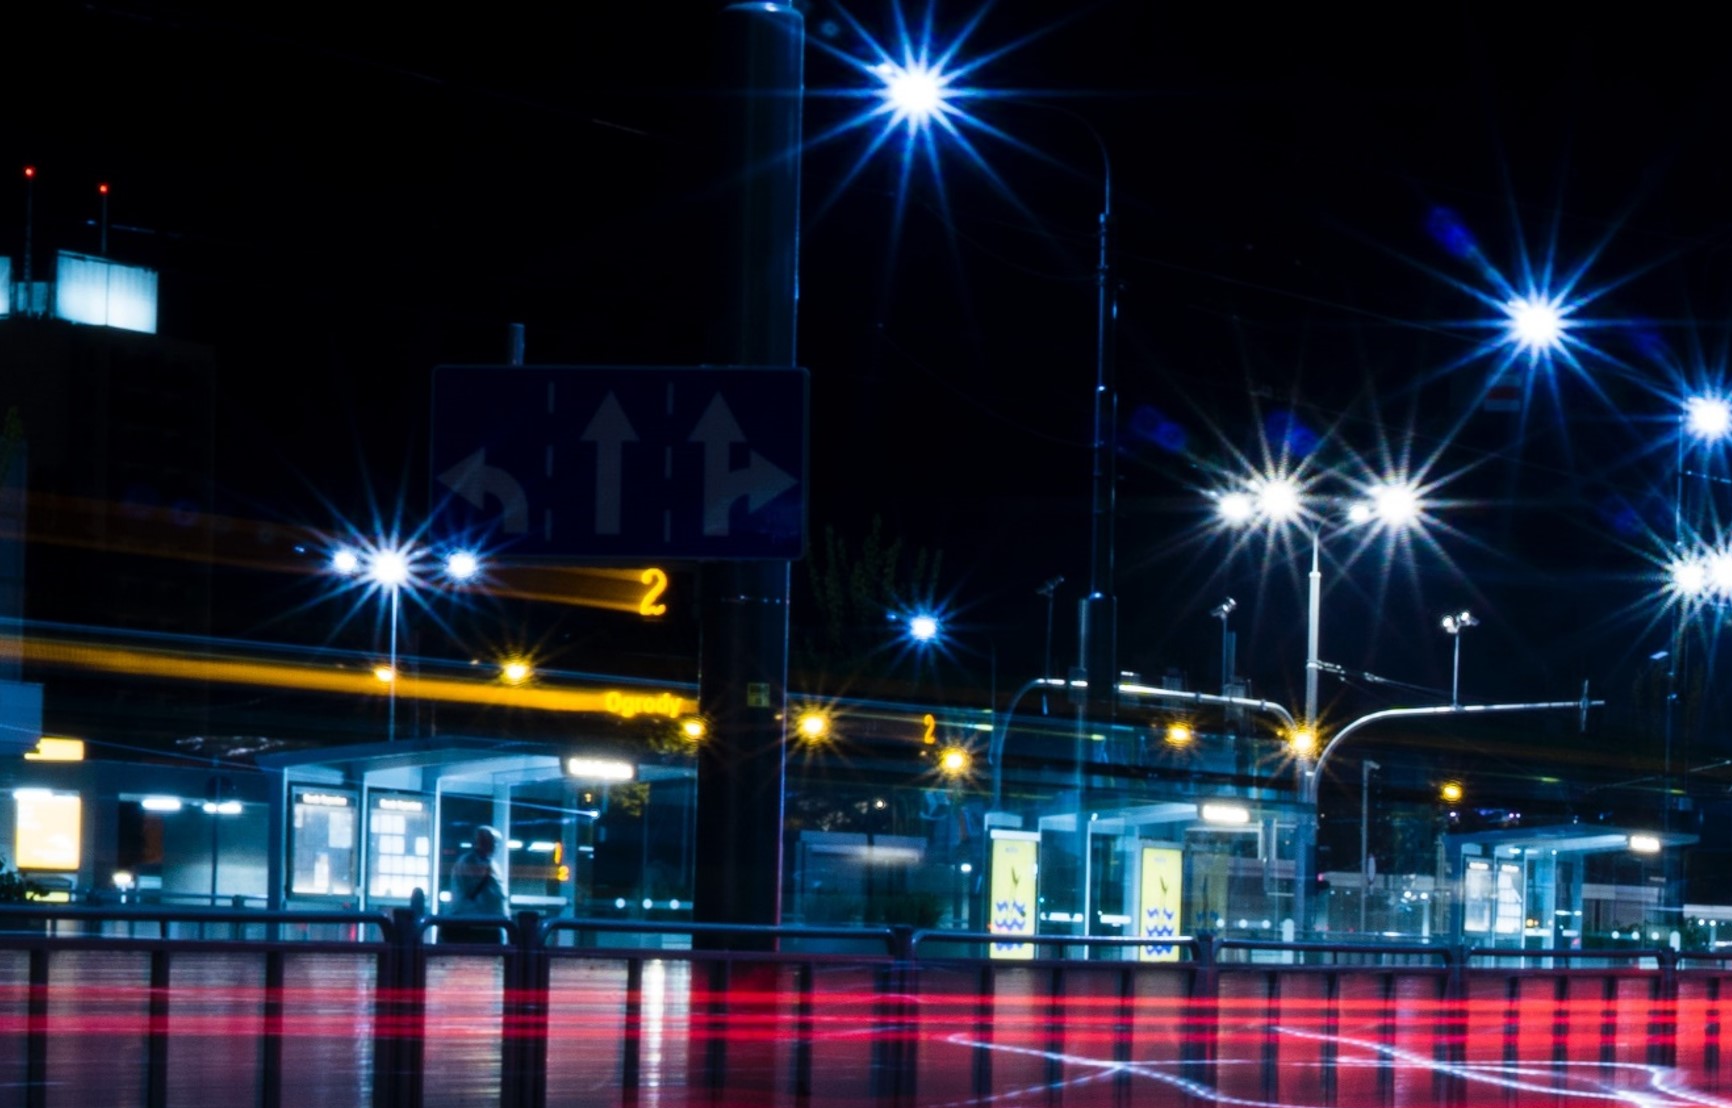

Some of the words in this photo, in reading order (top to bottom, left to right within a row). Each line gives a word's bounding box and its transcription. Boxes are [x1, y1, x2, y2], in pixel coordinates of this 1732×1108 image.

[640, 568, 668, 616] 2
[605, 691, 682, 718] Ogrody
[923, 714, 936, 744] 2
